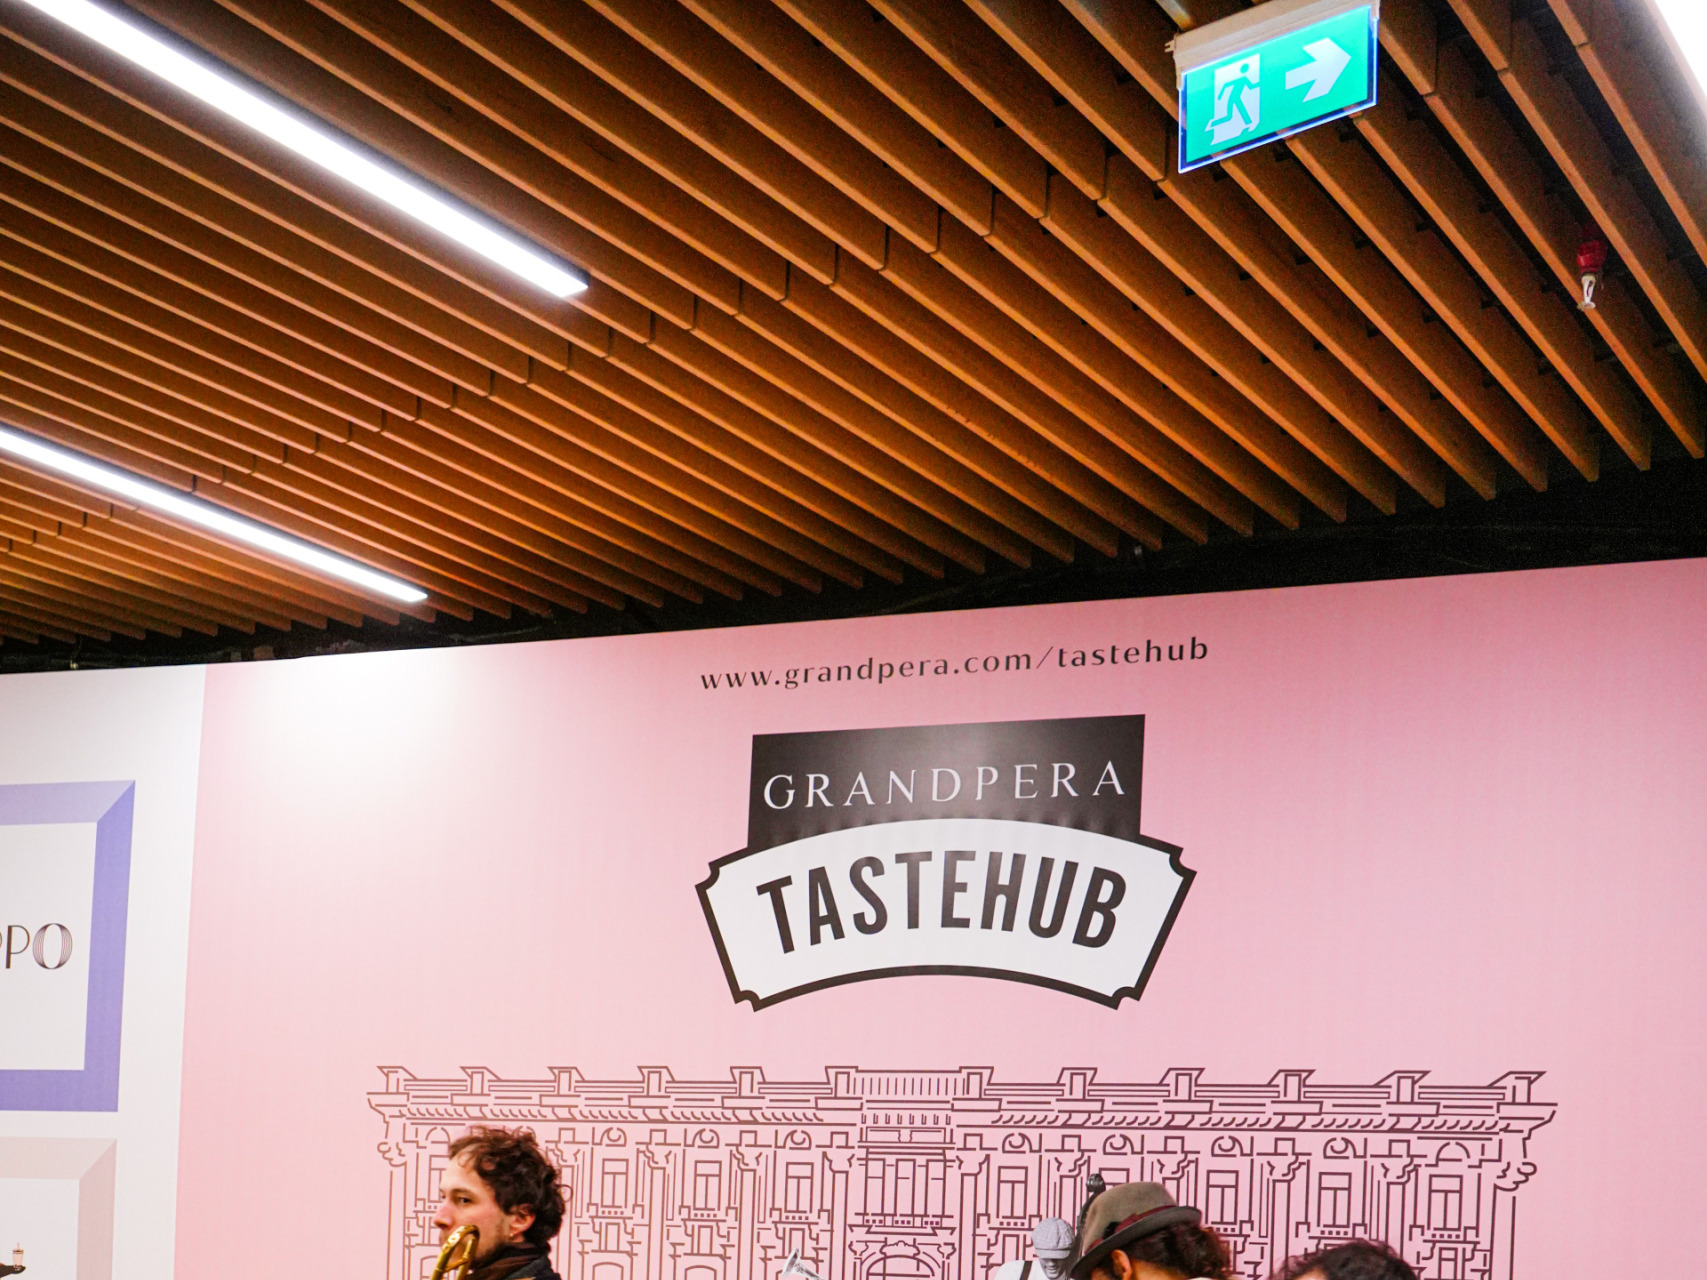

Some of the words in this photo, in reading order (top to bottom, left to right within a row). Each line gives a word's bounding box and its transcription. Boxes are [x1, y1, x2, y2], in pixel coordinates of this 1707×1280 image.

[700, 636, 1209, 690] www.grandpera.com/tastehub
[763, 760, 1126, 809] GRANDPERA
[756, 850, 1127, 954] TASTEHUB
